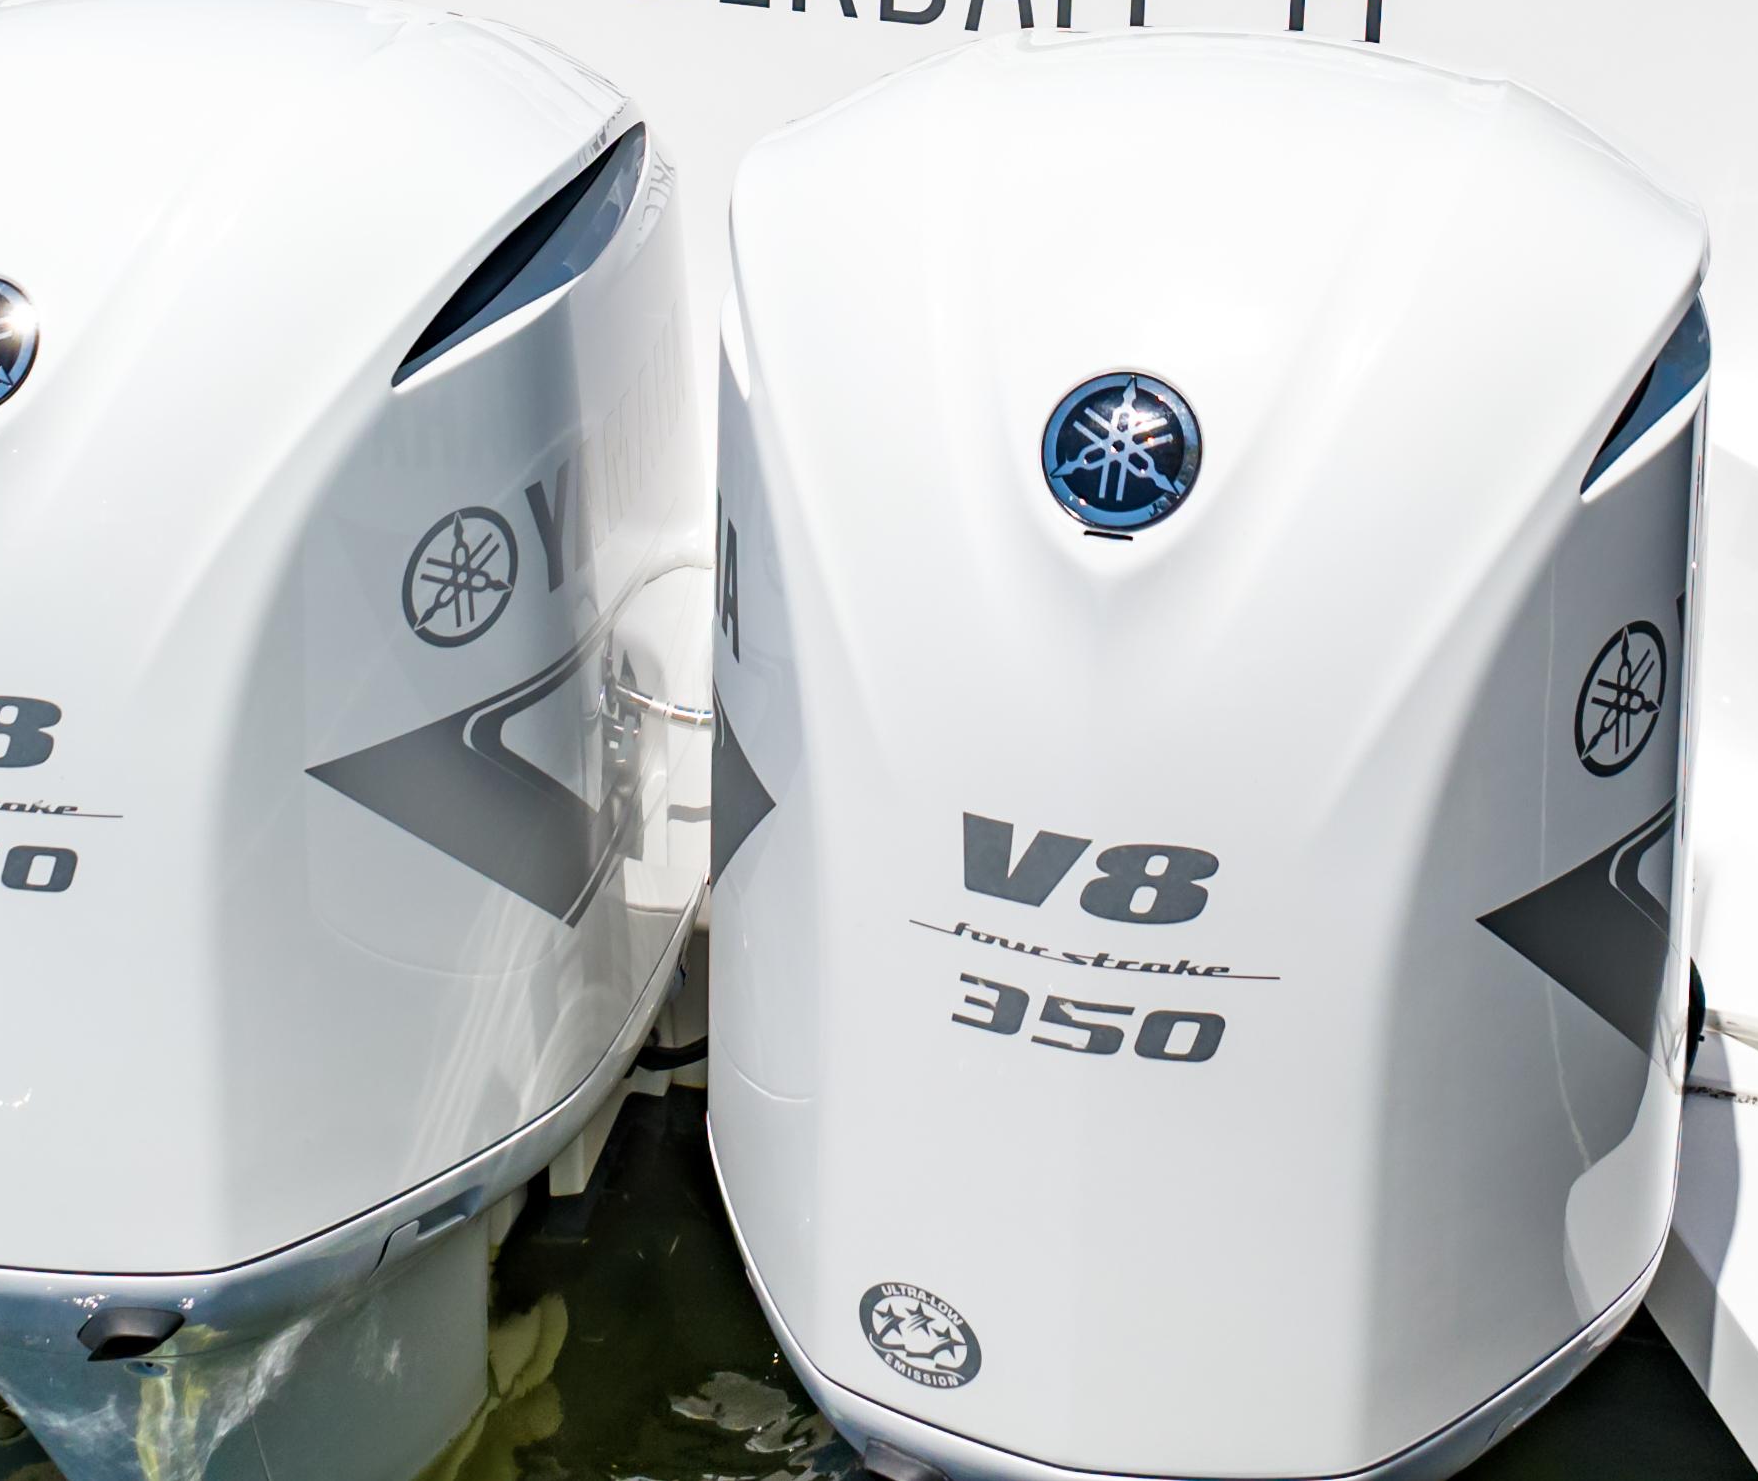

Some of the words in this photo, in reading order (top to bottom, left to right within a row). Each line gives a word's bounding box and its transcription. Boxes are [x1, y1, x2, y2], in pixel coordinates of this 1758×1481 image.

[962, 811, 1220, 925] V8
[952, 921, 1049, 957] four
[1061, 951, 1231, 977] stroke
[951, 972, 1227, 1063] 350
[881, 1284, 964, 1327] ULTRA-LOW
[884, 1352, 960, 1387] EMISSION
